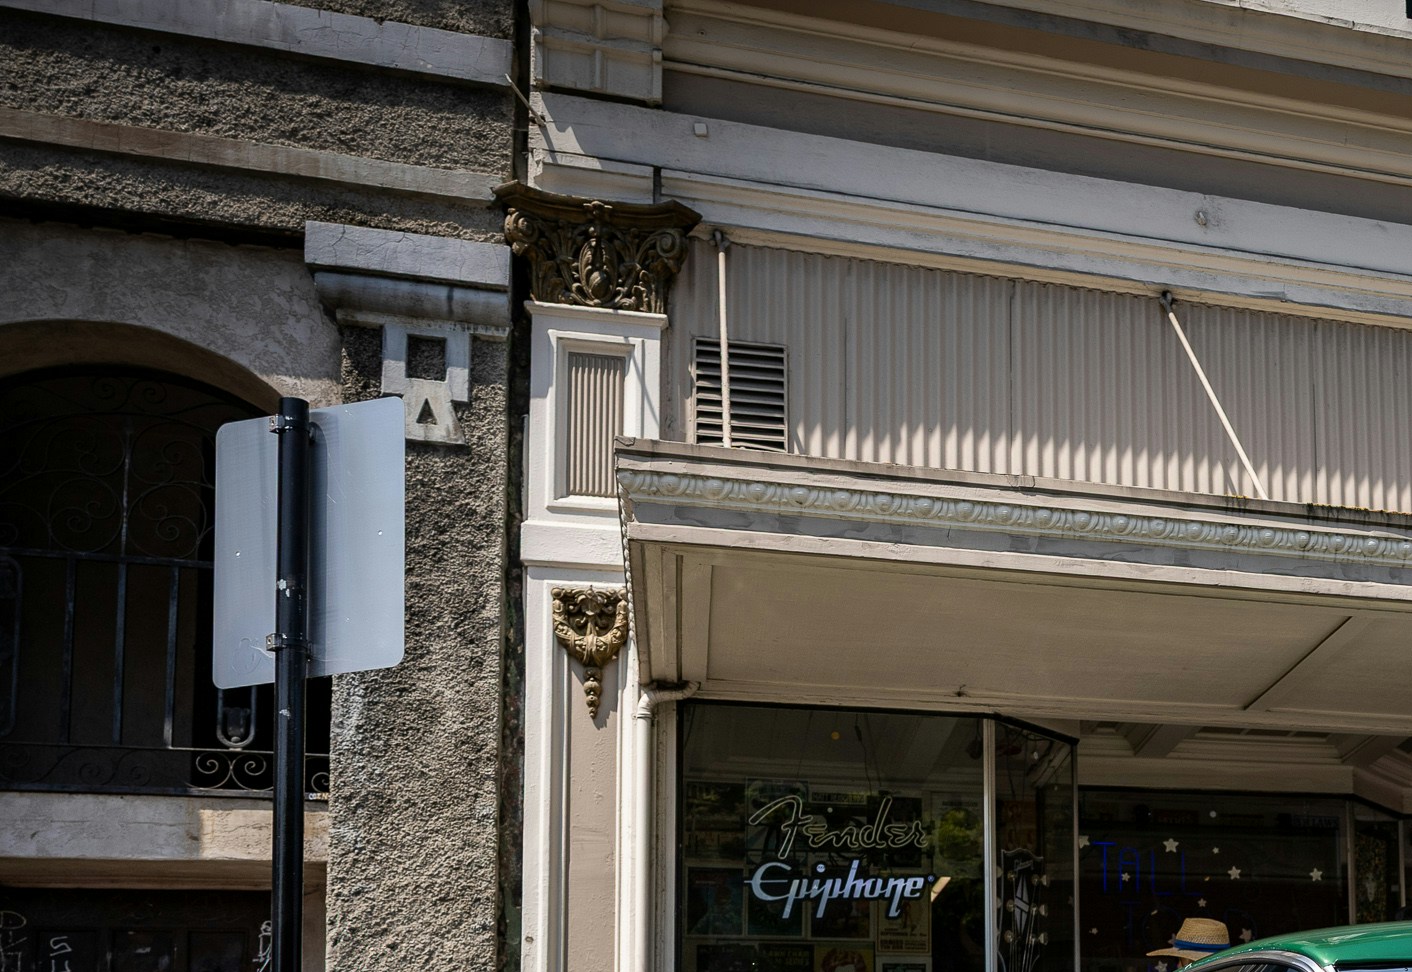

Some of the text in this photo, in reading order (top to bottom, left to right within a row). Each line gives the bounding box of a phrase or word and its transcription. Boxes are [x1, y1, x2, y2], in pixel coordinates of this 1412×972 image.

[748, 795, 929, 860] Fender
[743, 858, 926, 920] Epiphone
[1091, 840, 1206, 897] TALL
